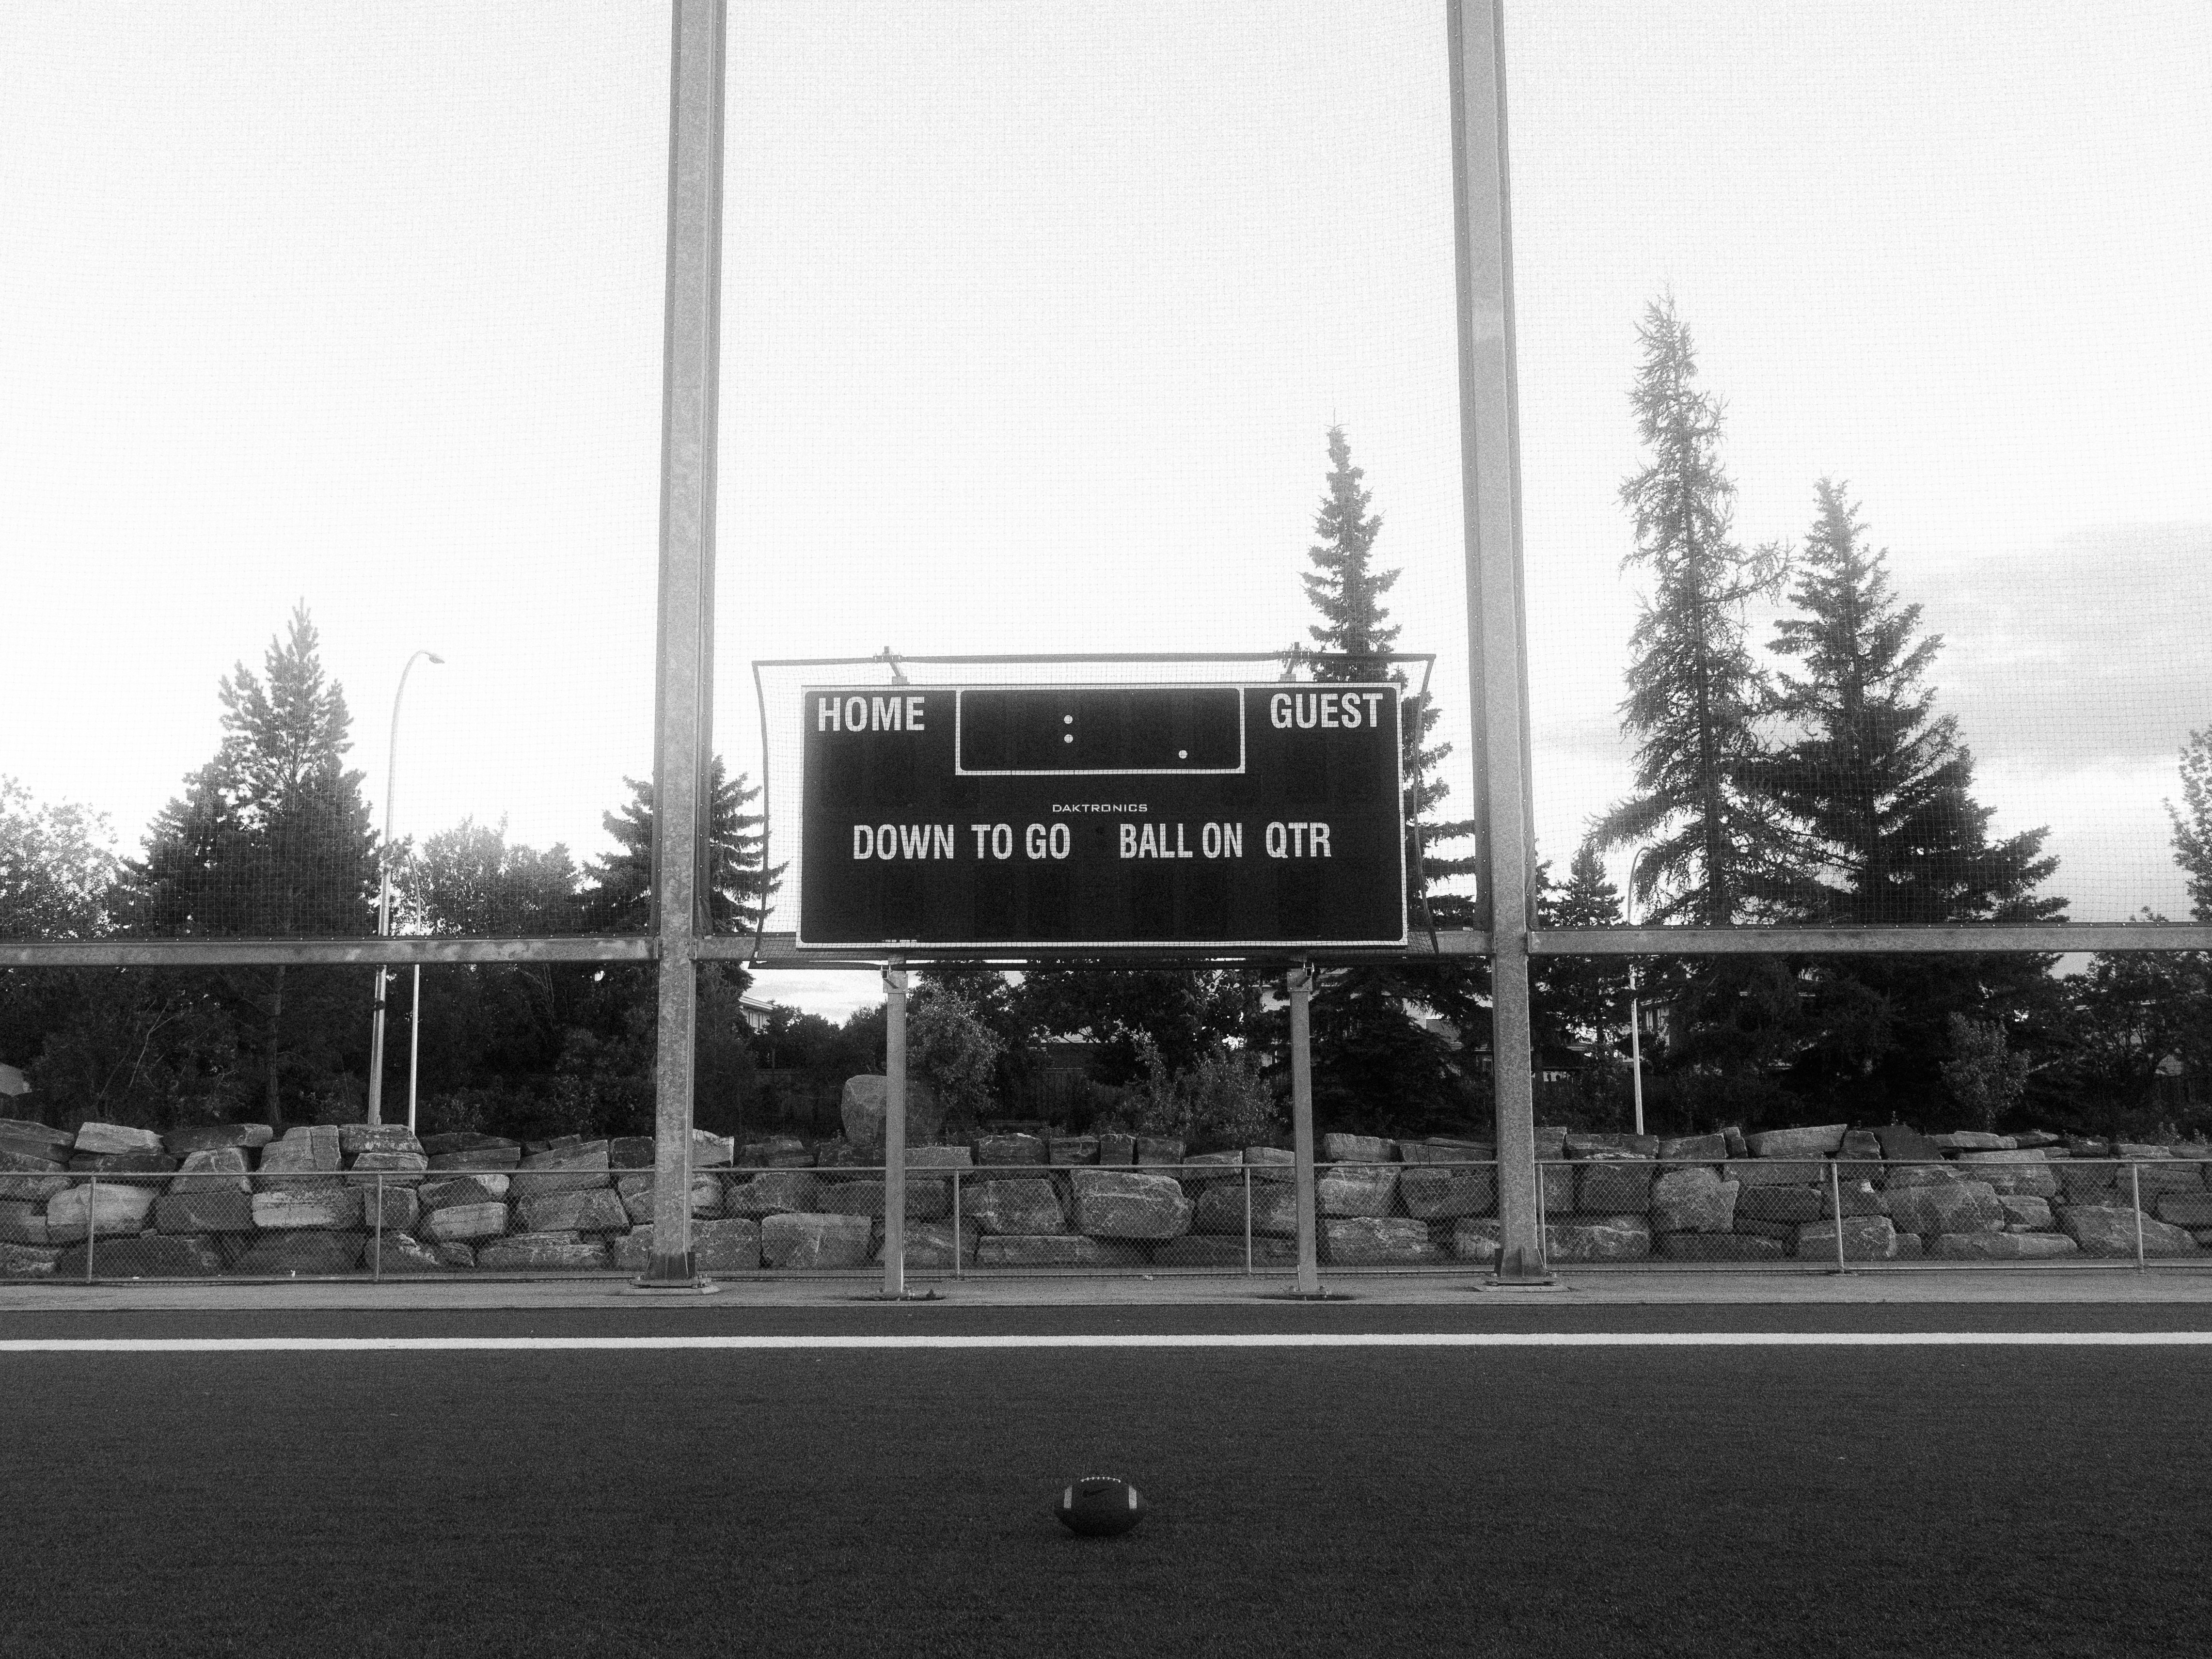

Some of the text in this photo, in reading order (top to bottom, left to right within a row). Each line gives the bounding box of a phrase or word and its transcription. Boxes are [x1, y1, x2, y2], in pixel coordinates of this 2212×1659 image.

[818, 695, 925, 732] HOME
[1270, 692, 1384, 729] GUEST
[1052, 804, 1148, 813] DAKTRONICS
[853, 824, 954, 860] DOWN
[971, 822, 1071, 860] TO GO
[1120, 822, 1243, 859] BALL ON
[1265, 821, 1332, 859] QTR
